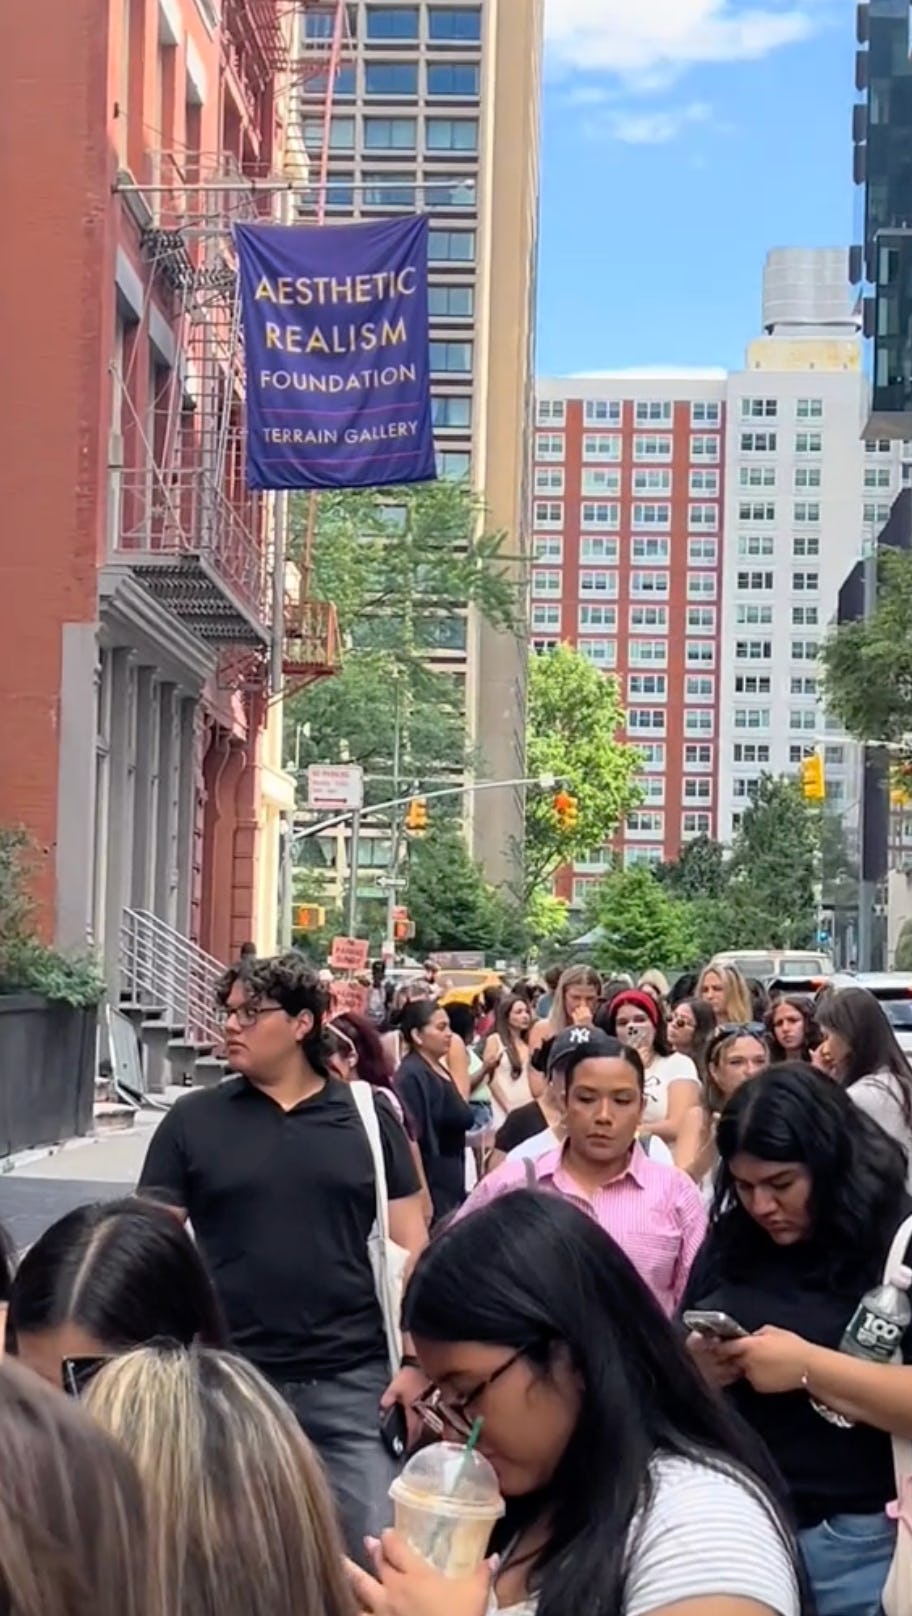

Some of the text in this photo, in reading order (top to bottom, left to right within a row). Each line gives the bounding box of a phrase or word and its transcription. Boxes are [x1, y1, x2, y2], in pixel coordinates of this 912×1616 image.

[255, 267, 417, 305] AESTHETIC
[265, 317, 407, 353] REALISM
[260, 363, 416, 393] FOUNDATION
[263, 420, 418, 444] TERRAIN GALLERY
